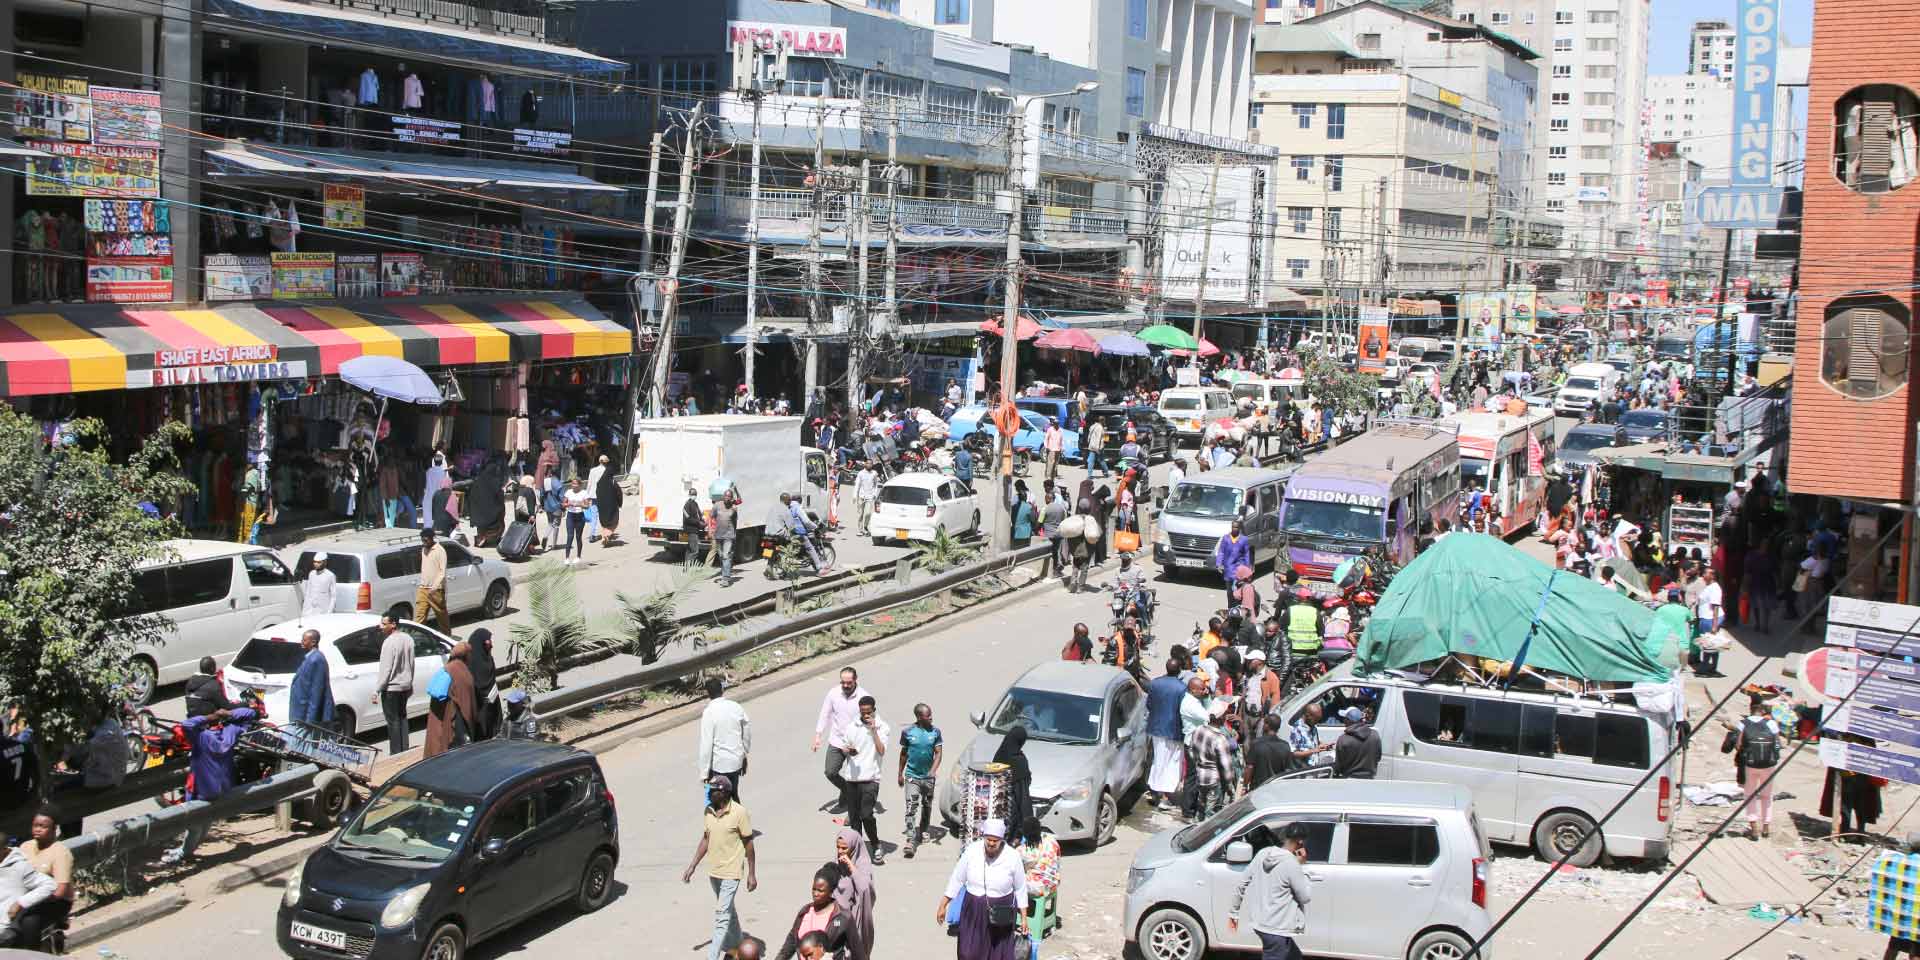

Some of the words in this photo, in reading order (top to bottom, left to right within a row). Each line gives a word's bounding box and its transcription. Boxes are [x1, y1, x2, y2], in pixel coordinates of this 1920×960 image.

[781, 30, 845, 52] PLAZA
[1739, 0, 1775, 179] OPPING
[161, 348, 198, 366] SHAFT
[202, 347, 230, 363] EAST
[231, 345, 272, 361] AFRICA
[152, 367, 207, 386] BILAL
[214, 363, 290, 382] TOWERS
[1291, 488, 1382, 506] VISIONARY
[317, 930, 344, 945] 439T
